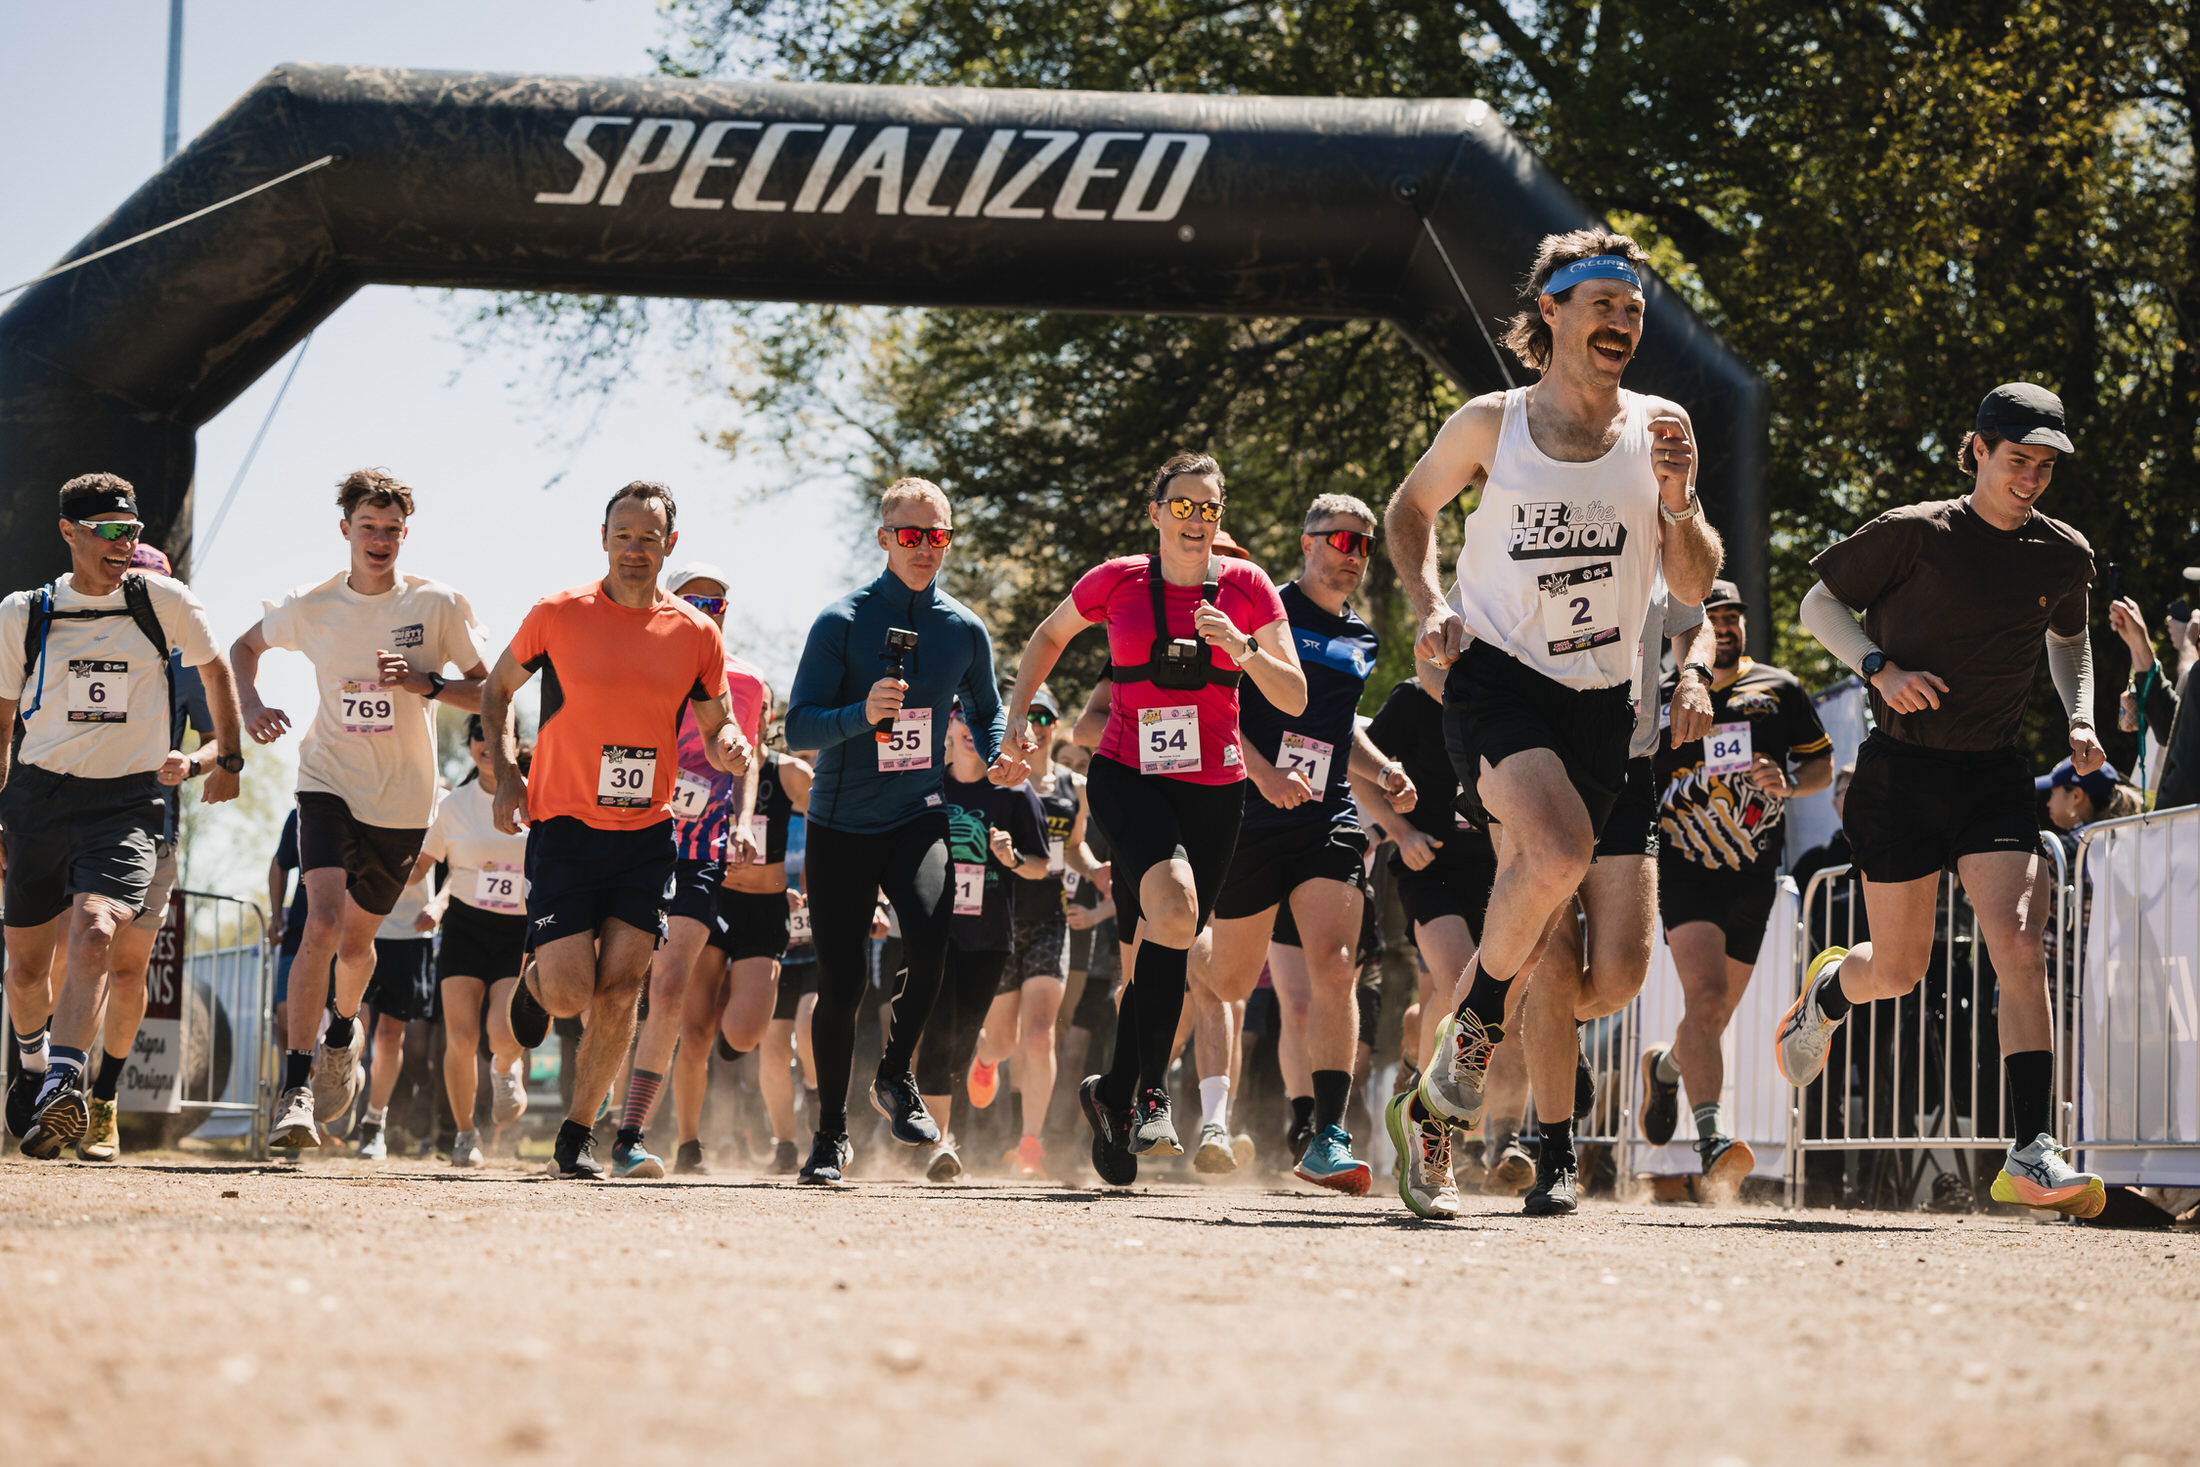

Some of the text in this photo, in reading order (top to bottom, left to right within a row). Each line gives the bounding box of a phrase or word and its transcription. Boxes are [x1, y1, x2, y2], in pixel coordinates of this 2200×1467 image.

[534, 114, 1211, 223] SPECIALIZED
[1511, 502, 1568, 529] LIFE
[1586, 500, 1616, 521] the
[1508, 522, 1627, 560] PELOTON
[1569, 597, 1592, 626] 2
[89, 682, 106, 703] 6
[343, 699, 391, 718] 769
[888, 730, 920, 751] 55
[1150, 729, 1187, 752] 54
[1713, 738, 1742, 758] 84
[610, 767, 644, 789] 30
[1288, 753, 1317, 779] 71
[486, 877, 512, 895] 78
[133, 1029, 166, 1063] Signs
[127, 1065, 174, 1100] Designs
